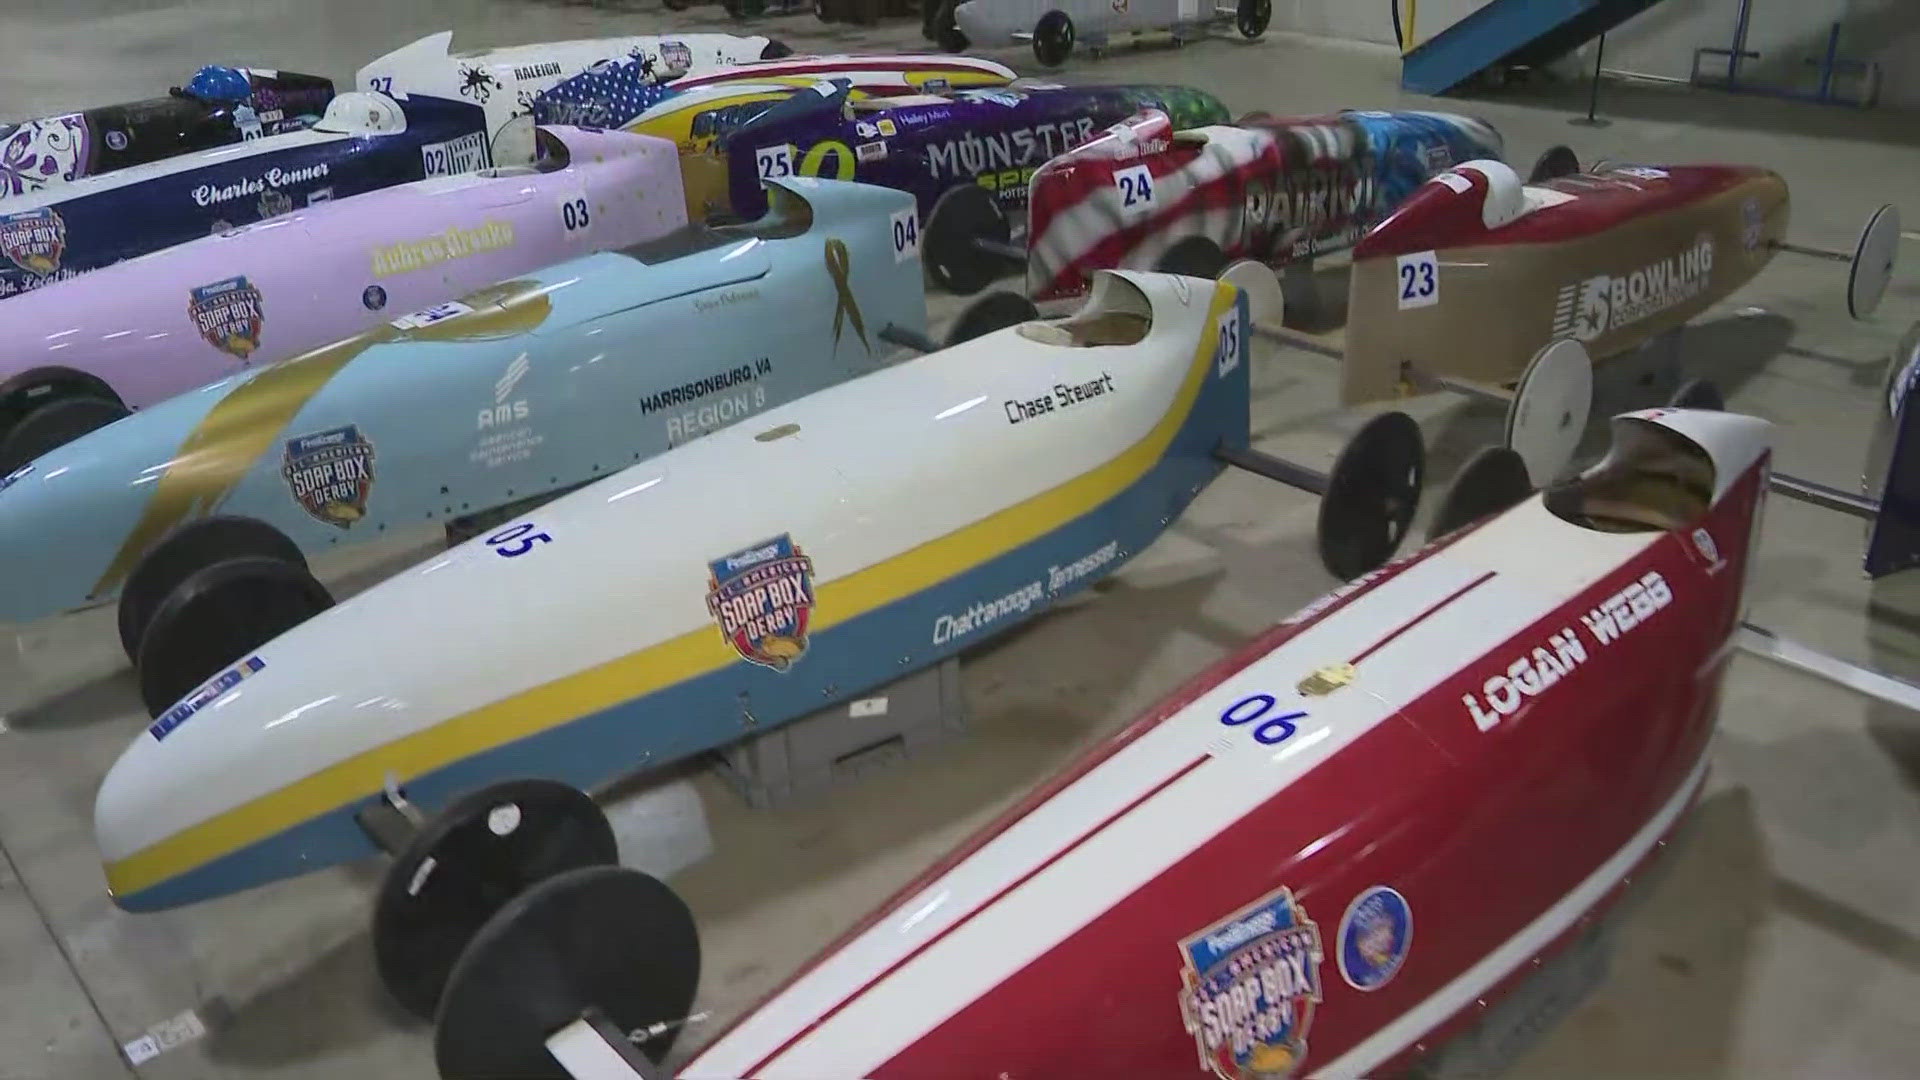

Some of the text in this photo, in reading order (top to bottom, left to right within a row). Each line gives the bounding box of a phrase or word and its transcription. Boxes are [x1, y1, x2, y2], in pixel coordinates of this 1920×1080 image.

[514, 61, 561, 81] RALEIGH
[425, 149, 446, 175] 02
[759, 152, 790, 179] 25
[191, 161, 331, 207] Charles Conner
[1119, 173, 1152, 208] 24
[562, 199, 590, 231] 03
[893, 216, 917, 252] 04
[1401, 262, 1434, 299] 23
[1611, 242, 1713, 307] BOWLING
[198, 306, 231, 332] SOAP
[230, 299, 259, 320] BOX
[1219, 319, 1236, 362] 05
[478, 400, 529, 430] AMS
[665, 387, 766, 442] REGION 8
[1004, 371, 1116, 424] Chase Stewart
[292, 456, 369, 497] SOAP BOX
[314, 480, 356, 505] DERBY
[486, 523, 553, 558] 05
[720, 572, 811, 634] SOAP BOX
[746, 604, 795, 640] DERBY
[1461, 570, 1674, 734] LOGAN WEBB
[1220, 694, 1308, 745] 06
[1199, 948, 1314, 1050] SOAP BOX
